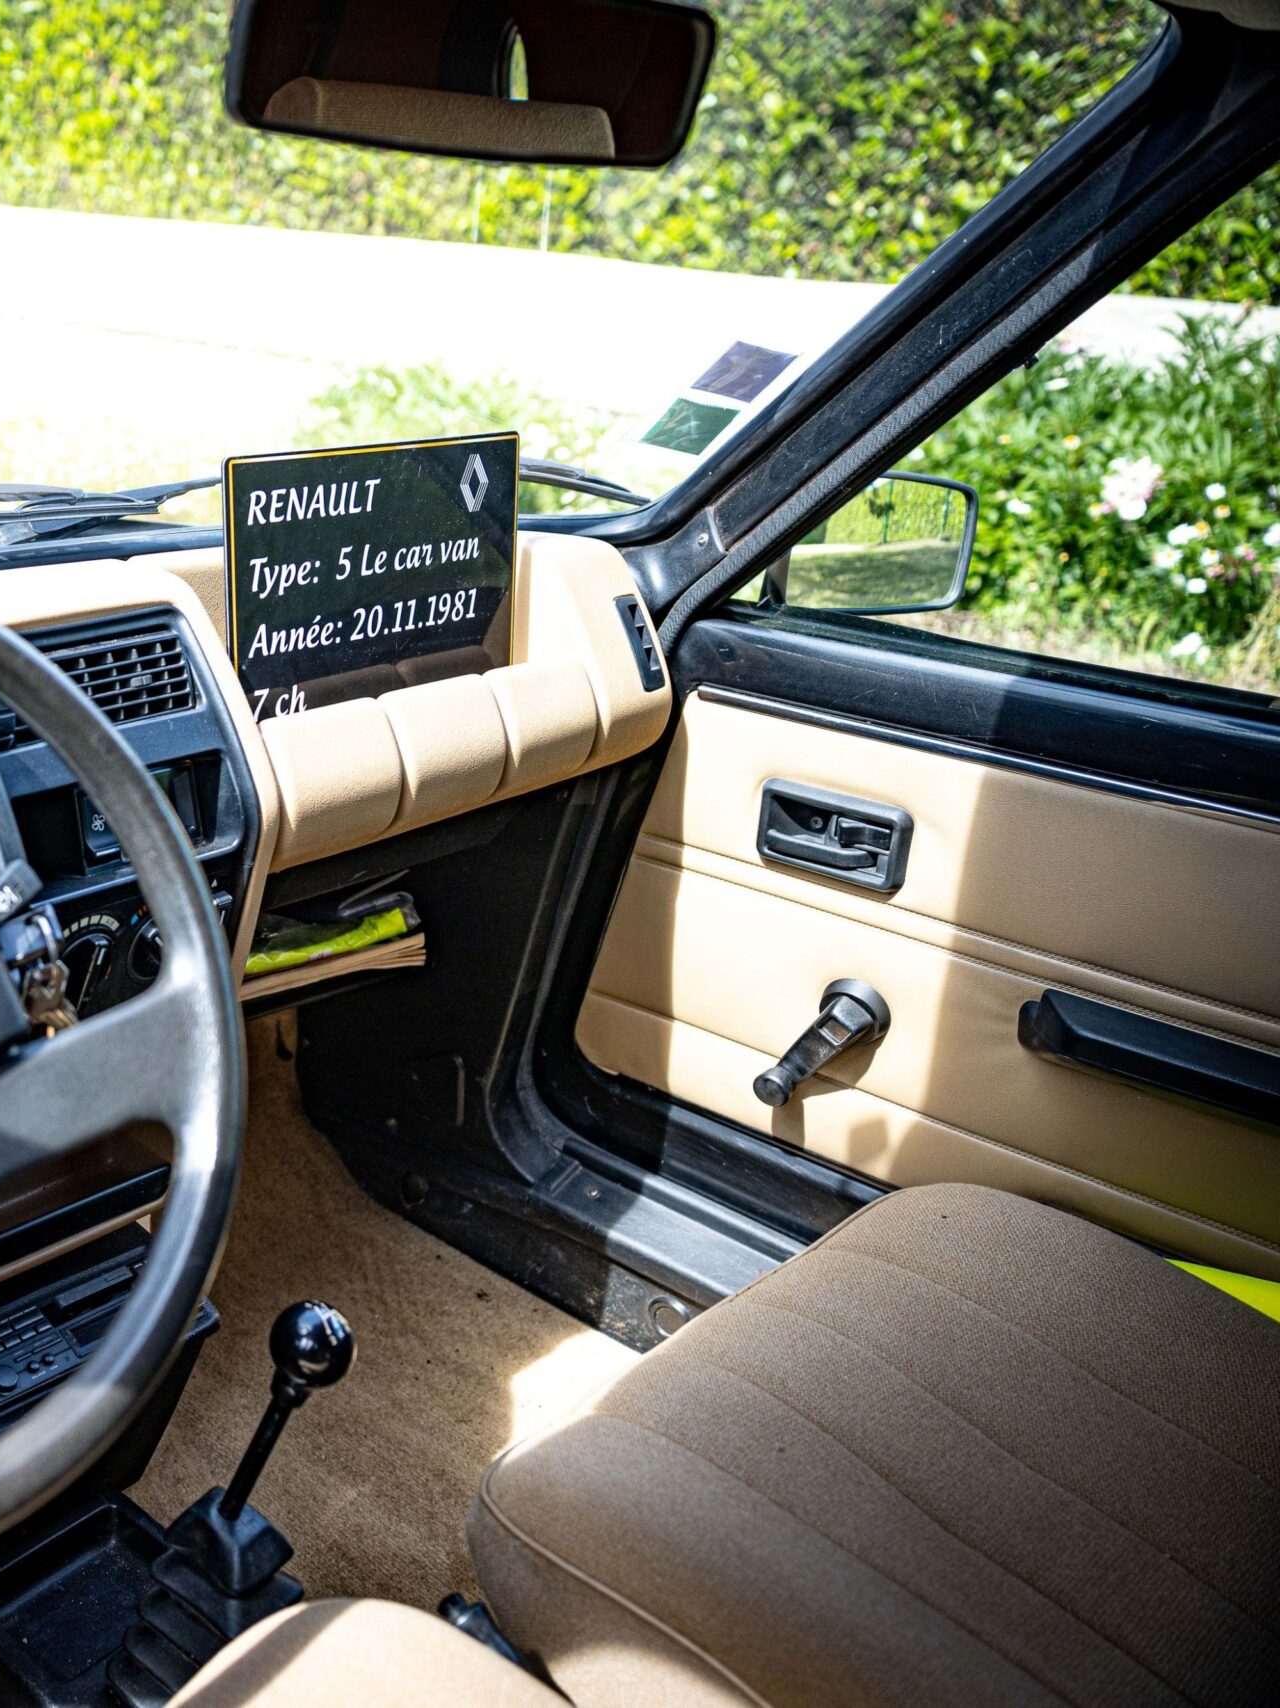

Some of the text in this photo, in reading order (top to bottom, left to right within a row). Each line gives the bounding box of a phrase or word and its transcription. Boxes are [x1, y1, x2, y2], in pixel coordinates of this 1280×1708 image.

[247, 478, 381, 525] RENAULT
[249, 536, 480, 599] Type: 5 Le car van
[247, 588, 477, 658] Année: 20.11.1981
[253, 684, 308, 723] 7 ch
